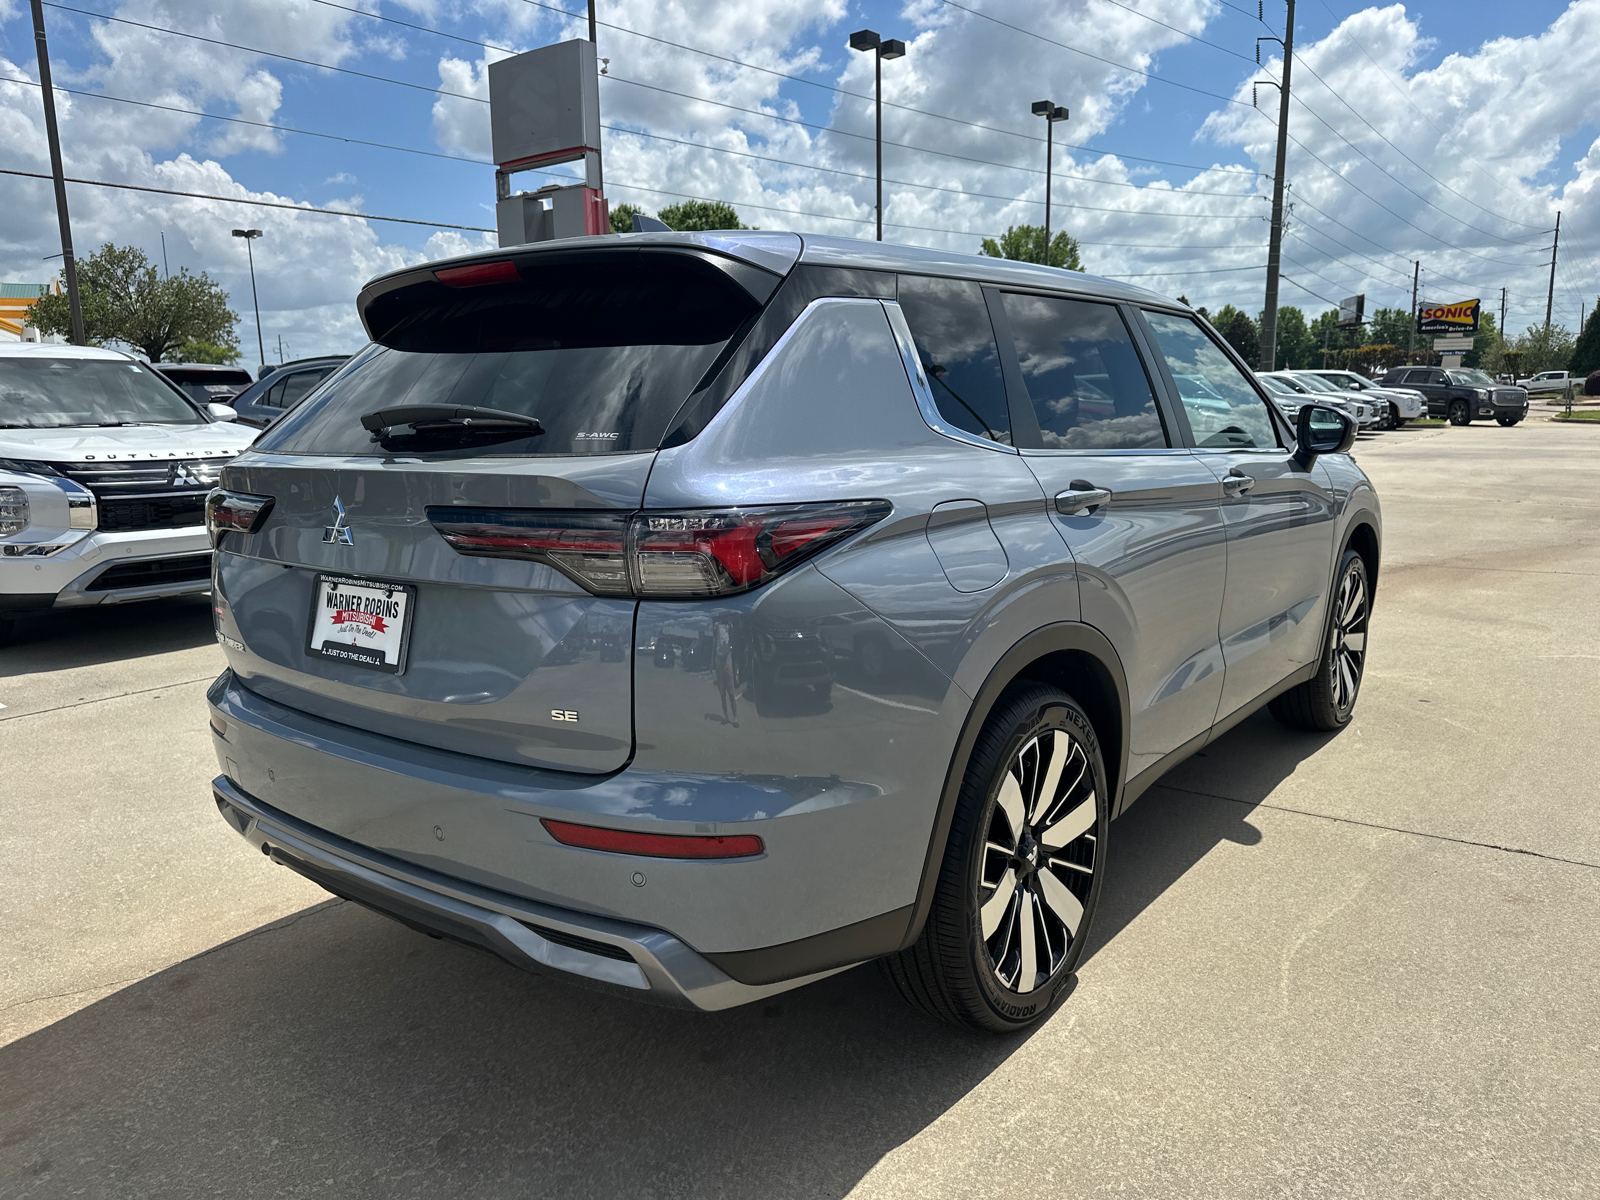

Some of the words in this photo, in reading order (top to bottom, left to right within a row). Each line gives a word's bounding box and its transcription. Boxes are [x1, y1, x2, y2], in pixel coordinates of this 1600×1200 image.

[1423, 306, 1474, 319] SONIC
[326, 591, 362, 611] WARNER
[364, 597, 399, 619] ROBINS
[341, 611, 377, 626] MITSUBISHI
[327, 648, 340, 657] JUST
[348, 652, 359, 661] THE
[359, 654, 375, 664] DEAL!
[551, 709, 578, 722] SE
[1066, 709, 1098, 754] NEXEN
